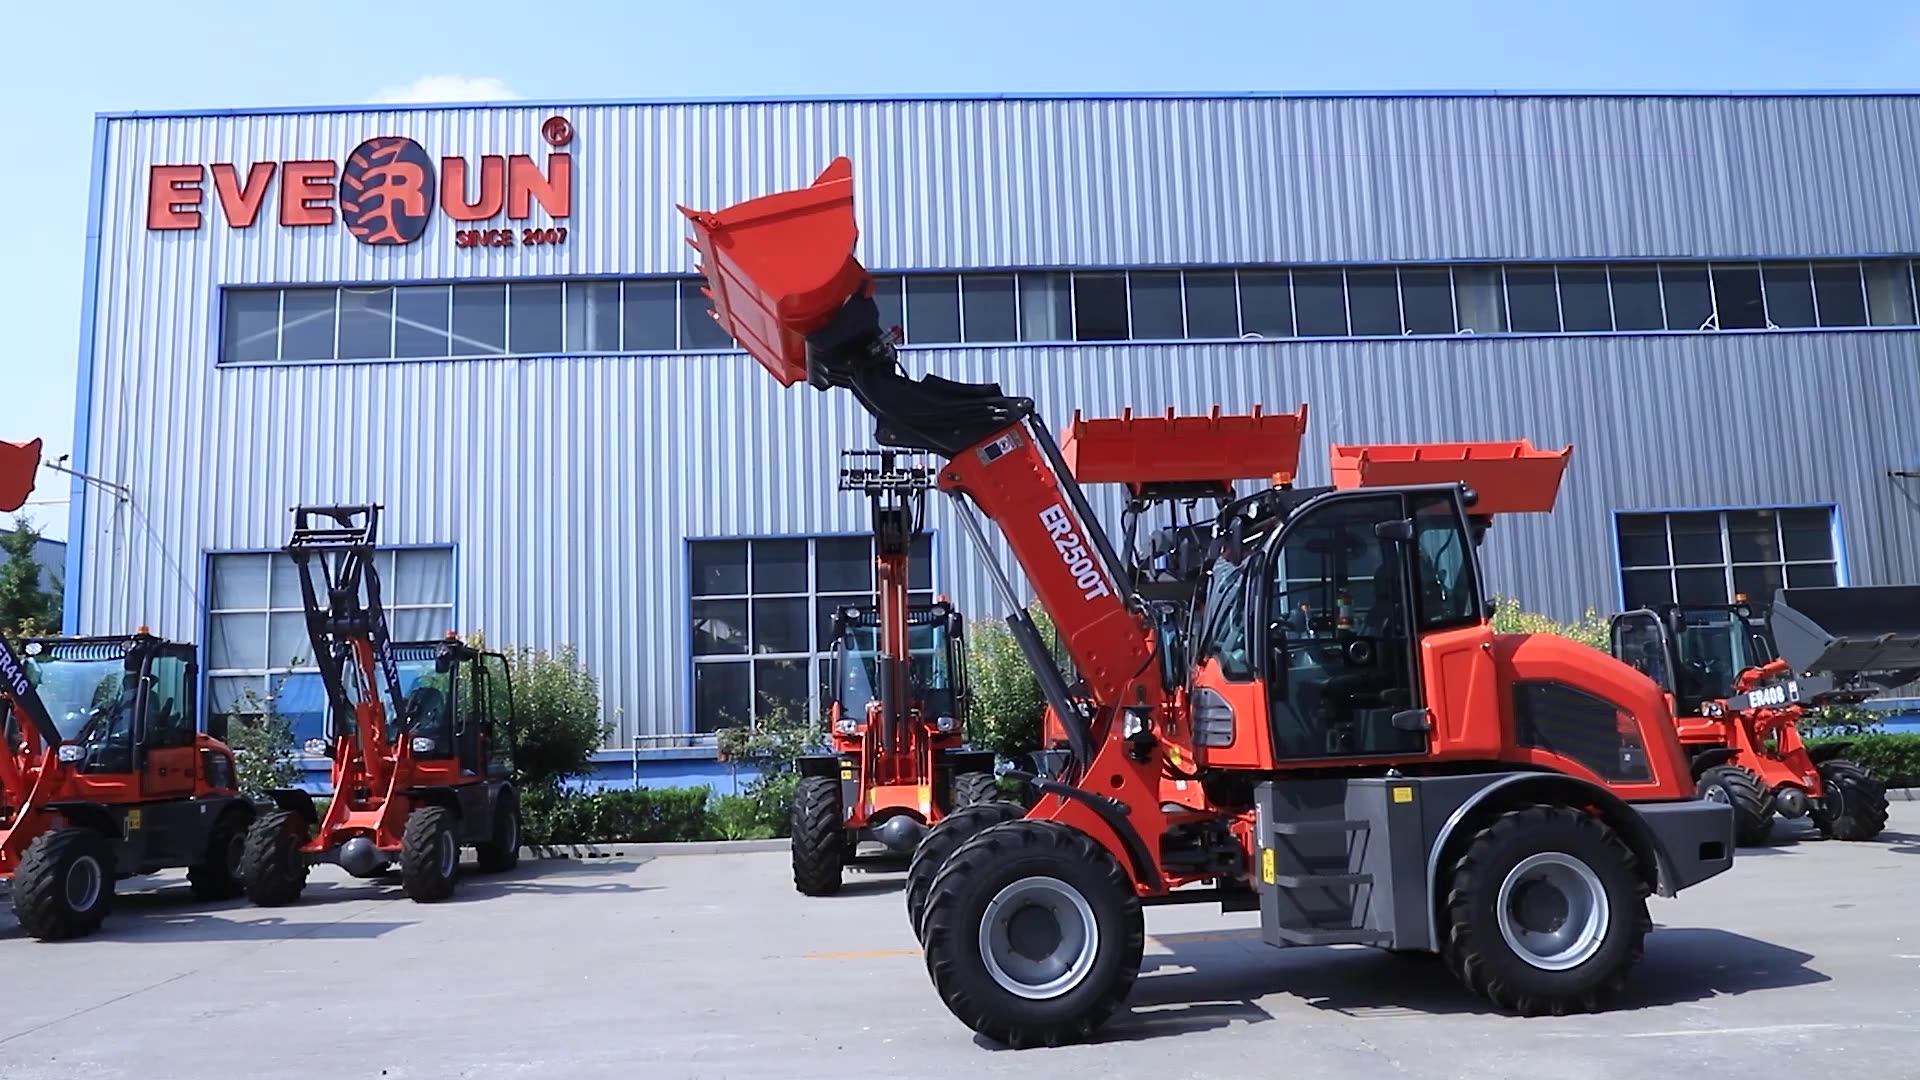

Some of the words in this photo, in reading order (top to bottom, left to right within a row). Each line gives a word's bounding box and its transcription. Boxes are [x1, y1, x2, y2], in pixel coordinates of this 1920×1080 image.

[455, 229, 514, 248] SINCE
[522, 227, 568, 246] 2007
[1039, 504, 1109, 601] ER2500T
[1749, 686, 1785, 708] ER408
